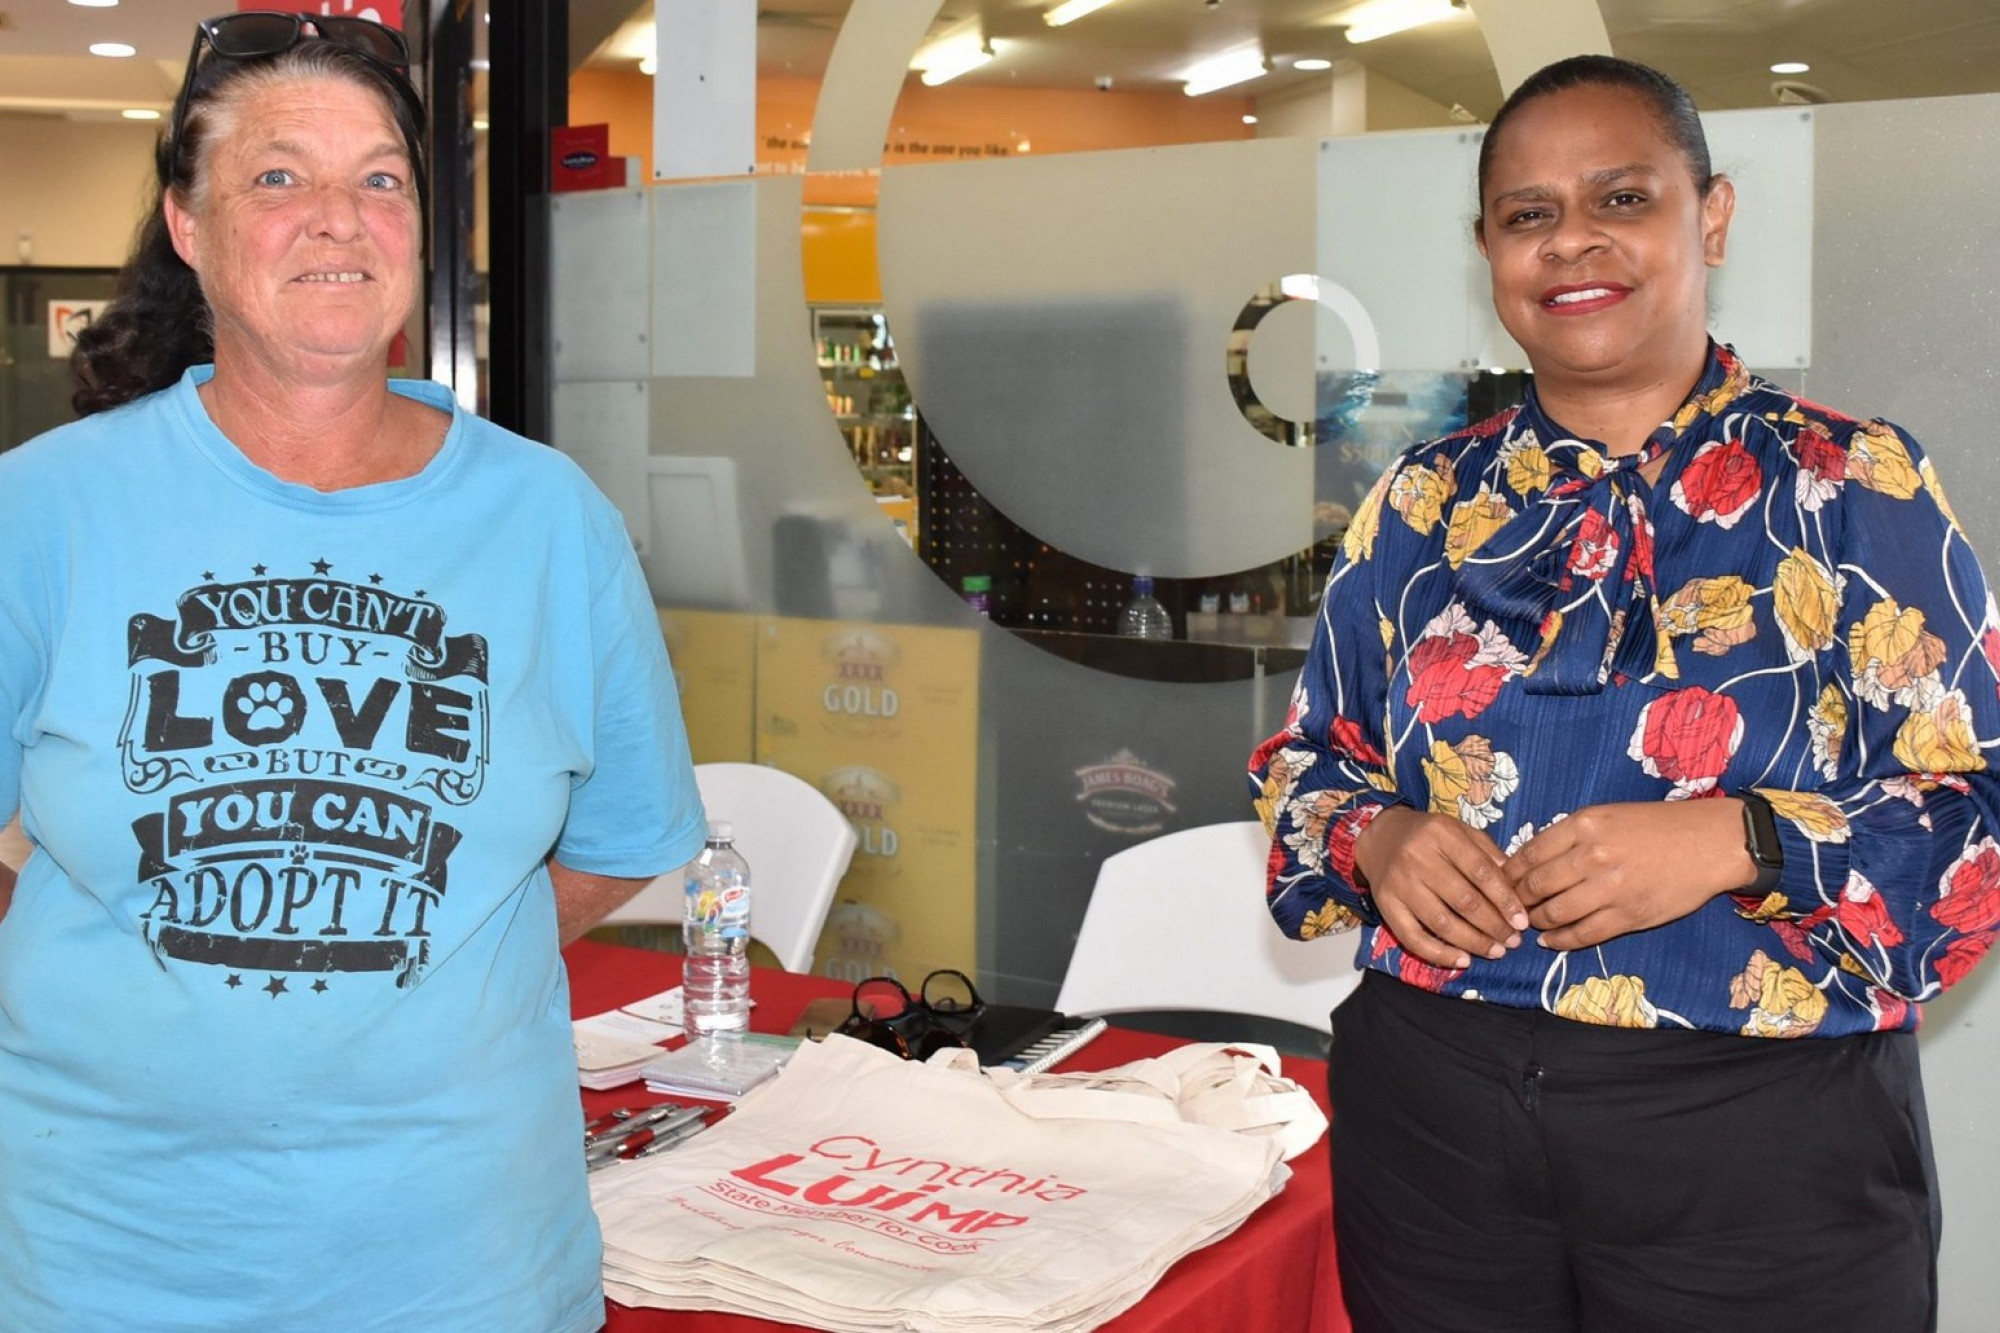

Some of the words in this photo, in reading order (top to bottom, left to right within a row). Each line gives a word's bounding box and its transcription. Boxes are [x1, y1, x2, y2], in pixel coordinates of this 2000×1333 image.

[196, 584, 291, 629] YOU
[303, 585, 437, 639] CAN'T
[839, 662, 883, 682] XXXX
[143, 669, 474, 763] LOVE
[823, 684, 899, 718] GOLD
[266, 748, 350, 777] BUT
[1082, 772, 1120, 792] JAMES
[178, 792, 295, 837] YOU
[313, 794, 426, 841] CAN
[139, 863, 361, 935] ADOPT
[372, 878, 440, 937] IT
[810, 1135, 1088, 1202] Cynthia
[709, 1180, 771, 1211] State
[773, 1203, 871, 1225] Member
[876, 1219, 915, 1237] for
[918, 1234, 984, 1252] Cook
[906, 1201, 1030, 1233] MP
